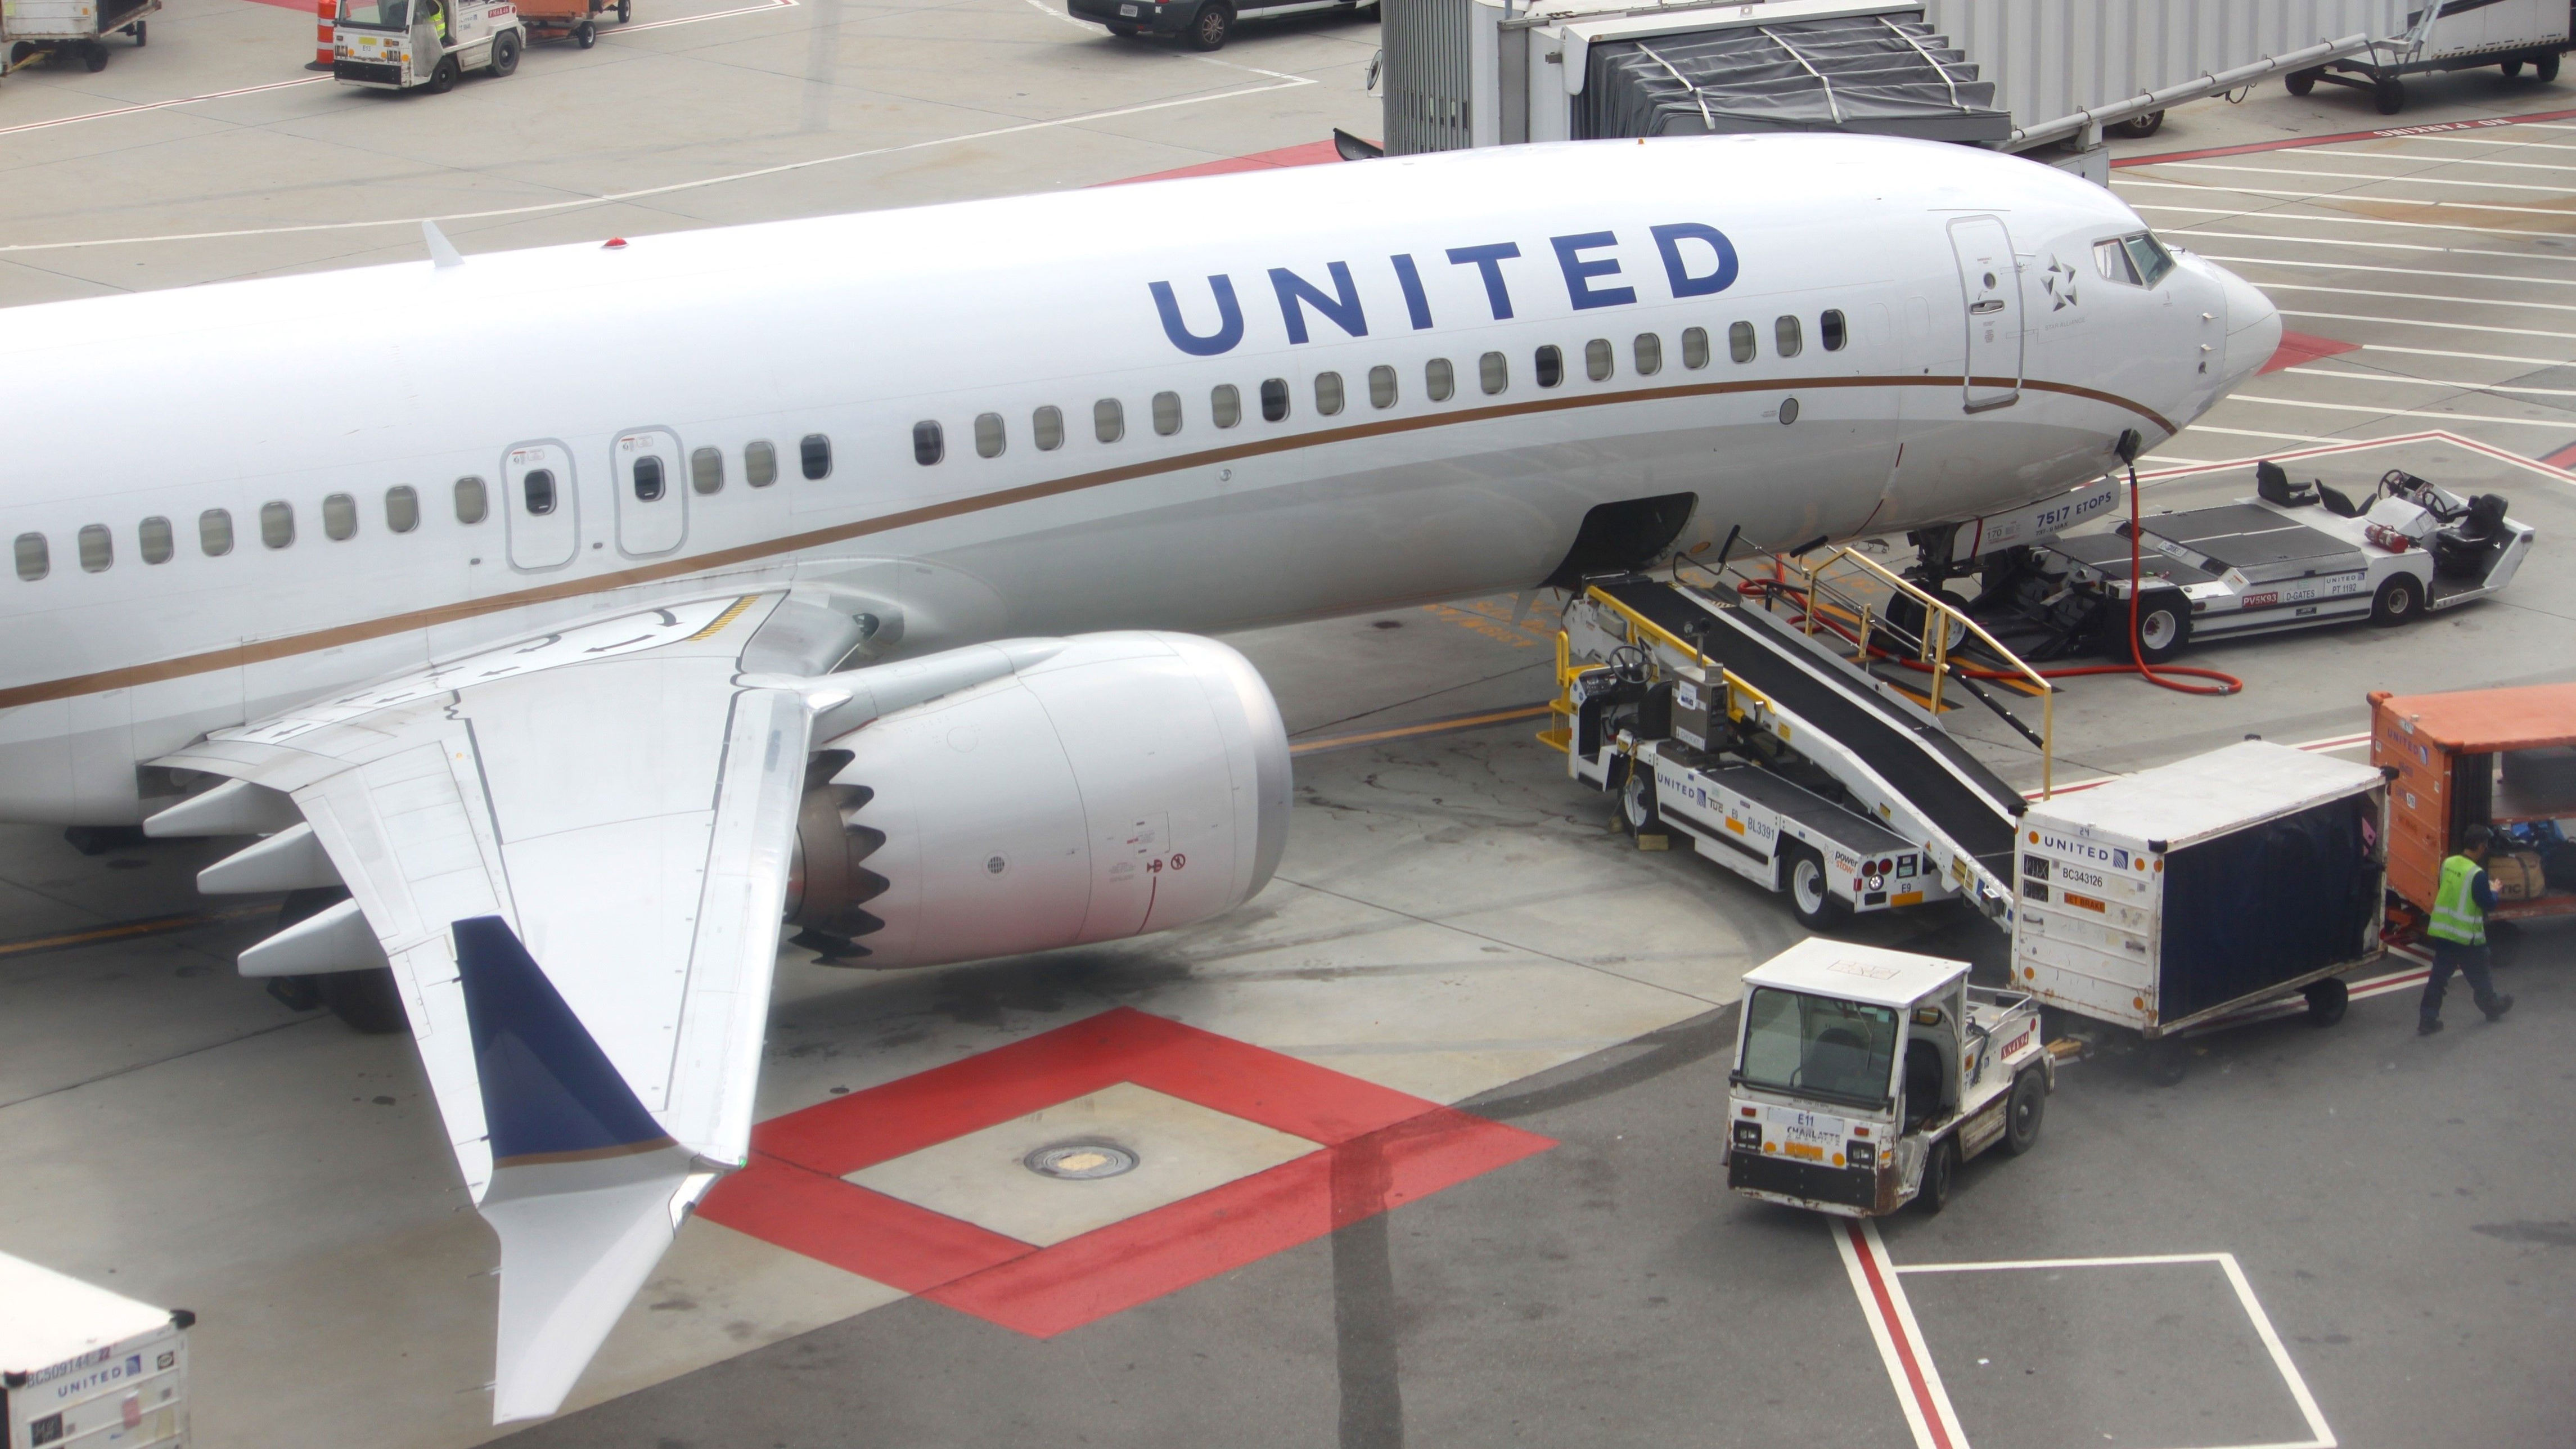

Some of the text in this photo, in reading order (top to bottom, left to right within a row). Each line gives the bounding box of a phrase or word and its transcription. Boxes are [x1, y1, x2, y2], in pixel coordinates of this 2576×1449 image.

[2374, 123, 2471, 136] PARKING
[1148, 222, 1739, 356] UNITED
[2060, 317, 2086, 327] ALLIANCE
[2037, 506, 2070, 527] 7517
[2076, 492, 2111, 515] ETOPS
[1987, 529, 2002, 538] 170
[2326, 575, 2356, 584] UNITED
[2286, 590, 2315, 601] D-GATES
[2332, 584, 2357, 594] PT 1192
[2243, 593, 2277, 605] PV5K93
[2388, 728, 2419, 755] UNITED
[1658, 772, 1695, 798] UNITED
[1732, 809, 1738, 820] E9
[1748, 817, 1775, 841] BL3391
[2080, 827, 2089, 837] 24
[2044, 836, 2109, 861] UNITED
[1835, 851, 1858, 868] power
[1836, 861, 1853, 874] stow
[2063, 868, 2102, 887] BC343126
[1902, 883, 1911, 893] E9
[2080, 898, 2105, 912] BRAKE
[1798, 1113, 1813, 1126] E11
[58, 1367, 121, 1398] UNITED
